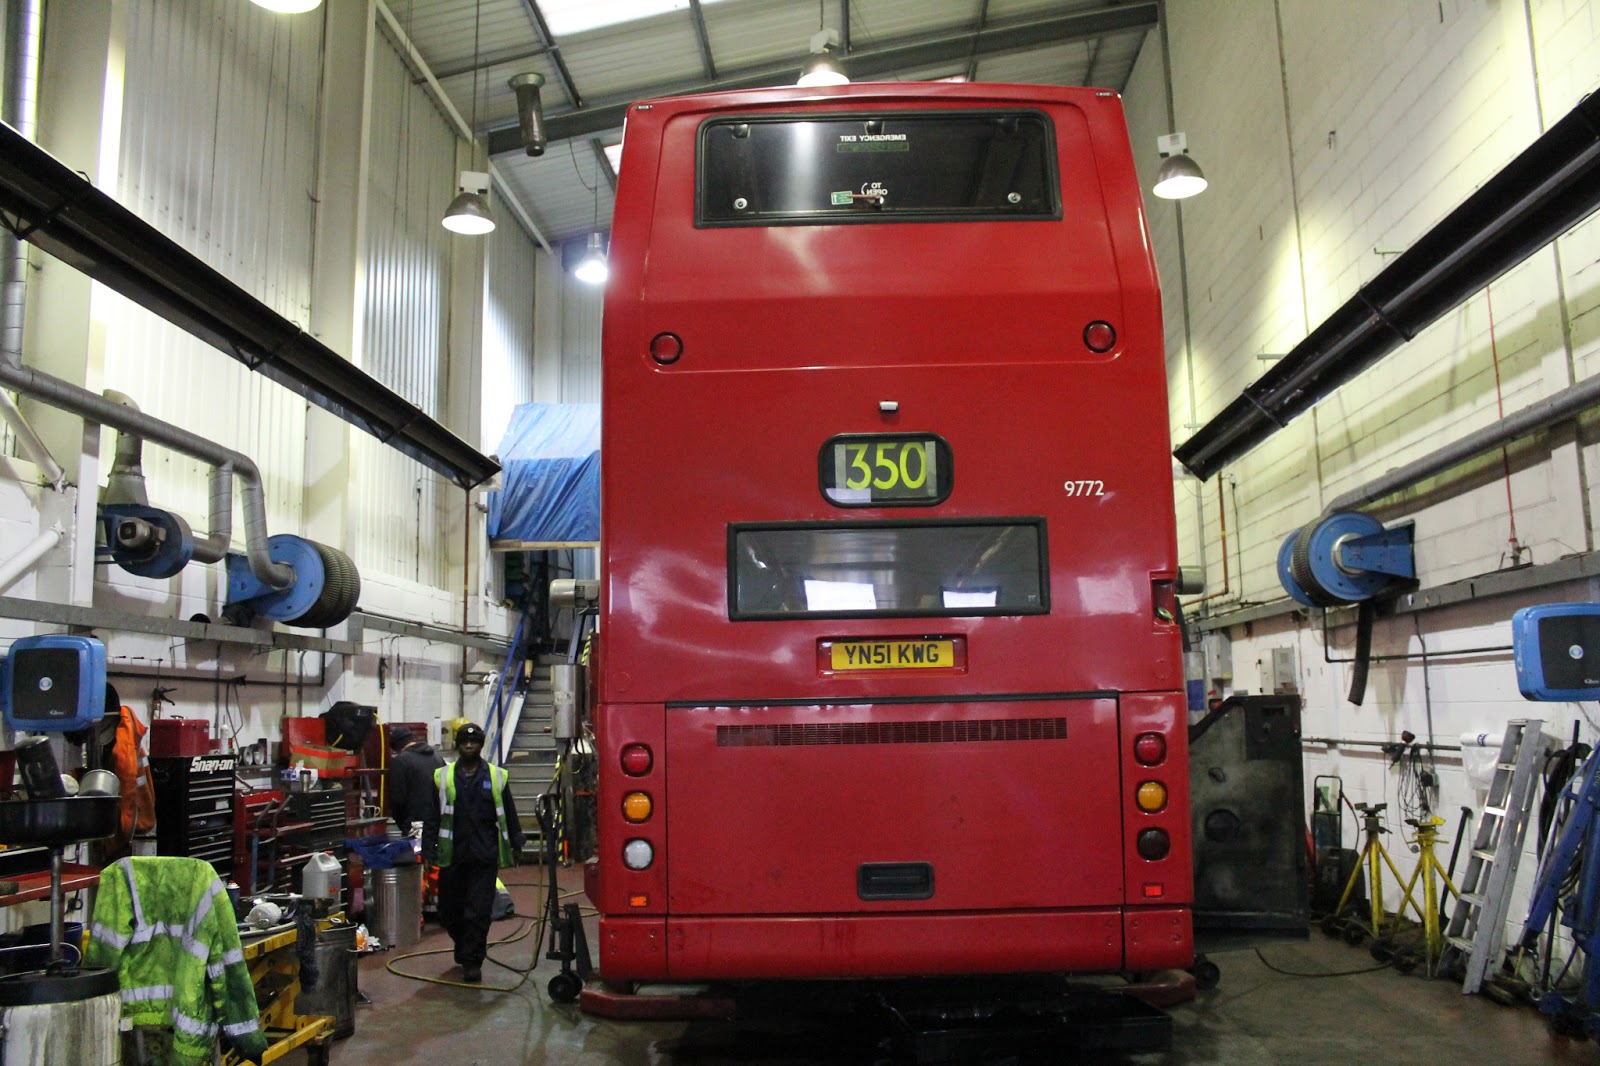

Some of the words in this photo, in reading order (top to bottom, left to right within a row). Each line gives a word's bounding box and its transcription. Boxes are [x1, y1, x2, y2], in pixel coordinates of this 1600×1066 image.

[846, 442, 927, 490] 350
[1063, 480, 1105, 497] 9772
[844, 644, 892, 665] YN51
[897, 643, 939, 663] KWG
[189, 756, 234, 774] Snap-on
